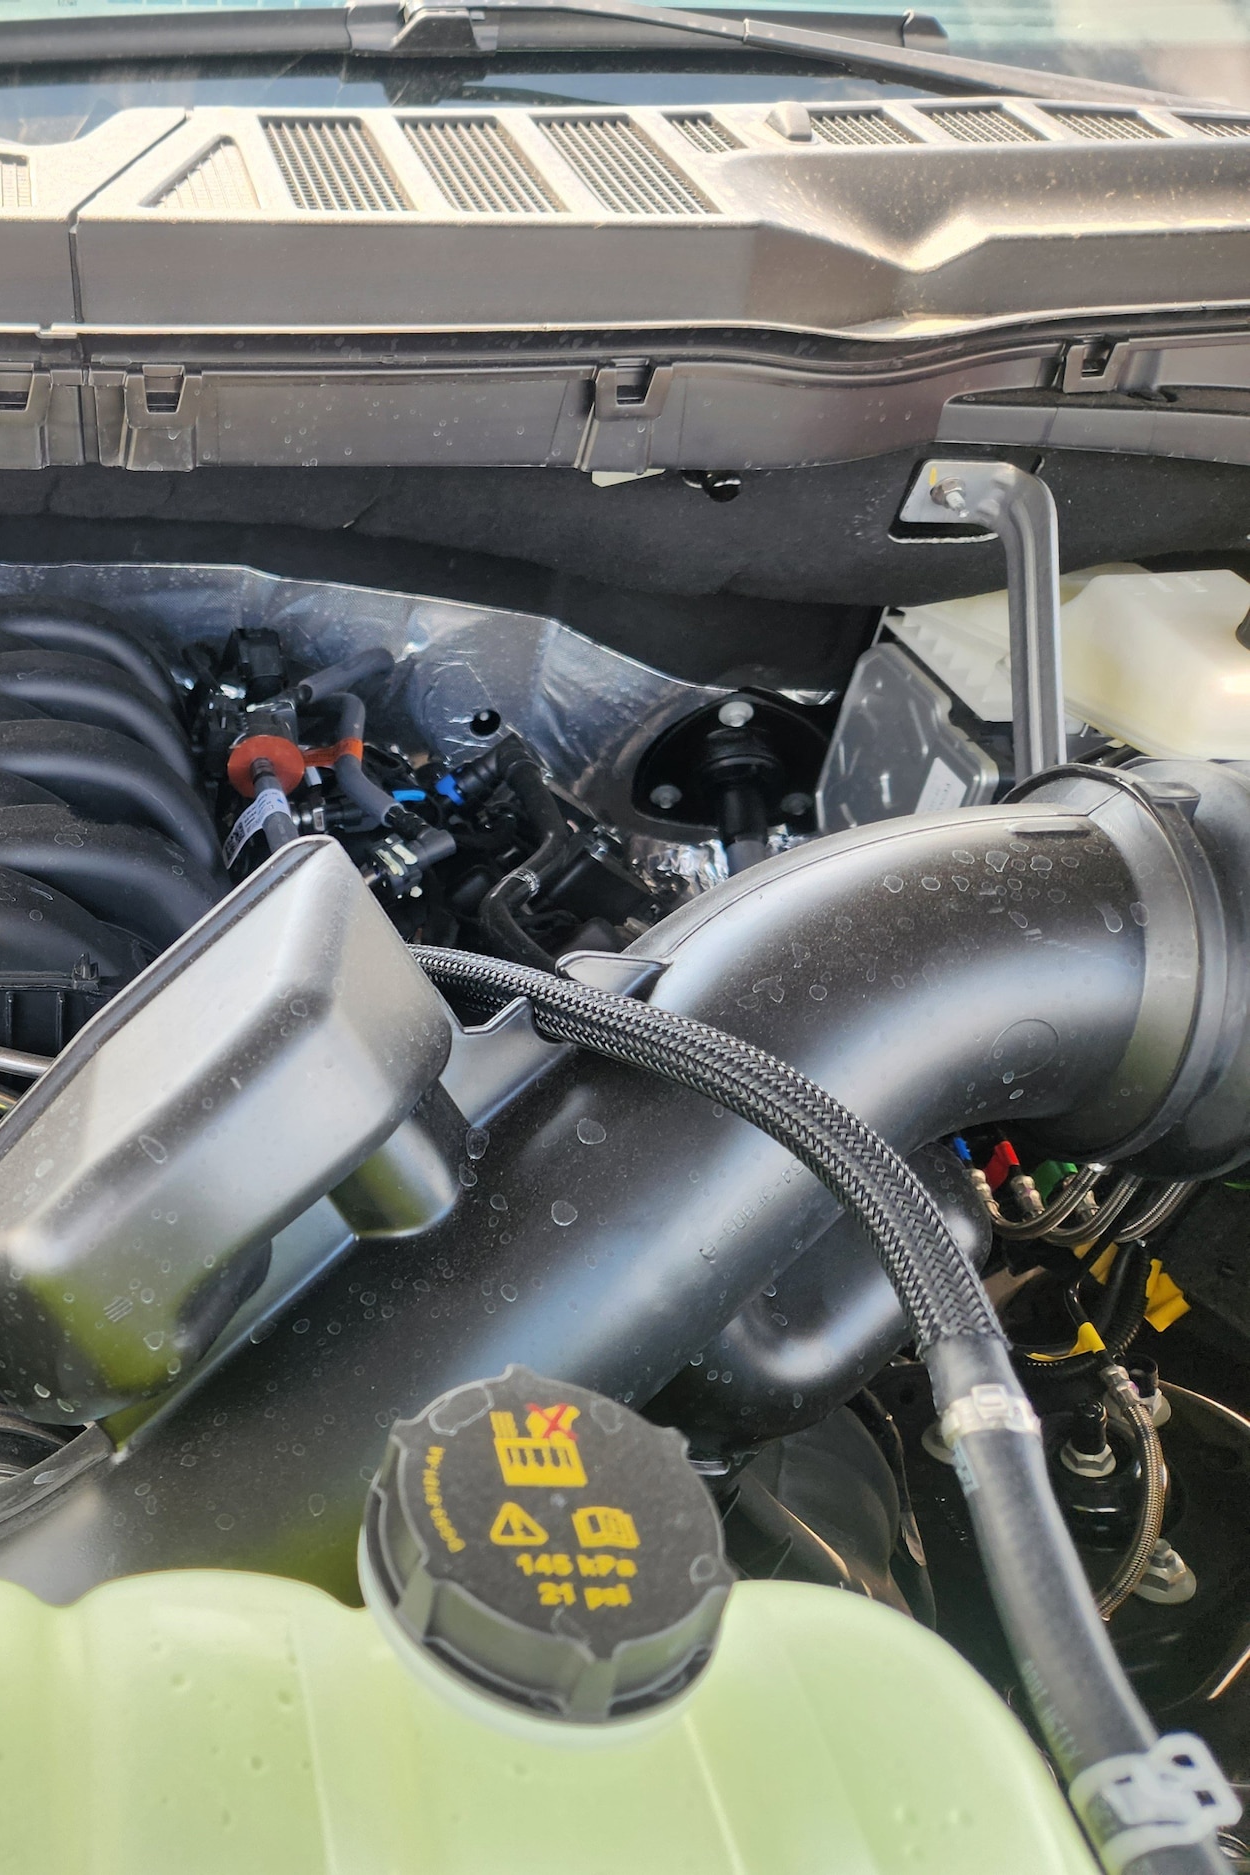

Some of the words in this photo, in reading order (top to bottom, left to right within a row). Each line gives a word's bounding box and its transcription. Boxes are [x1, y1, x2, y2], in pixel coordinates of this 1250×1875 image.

[516, 1553, 574, 1576] 145
[577, 1554, 638, 1578] kPa
[538, 1582, 577, 1606] 21
[584, 1583, 632, 1611] psi
